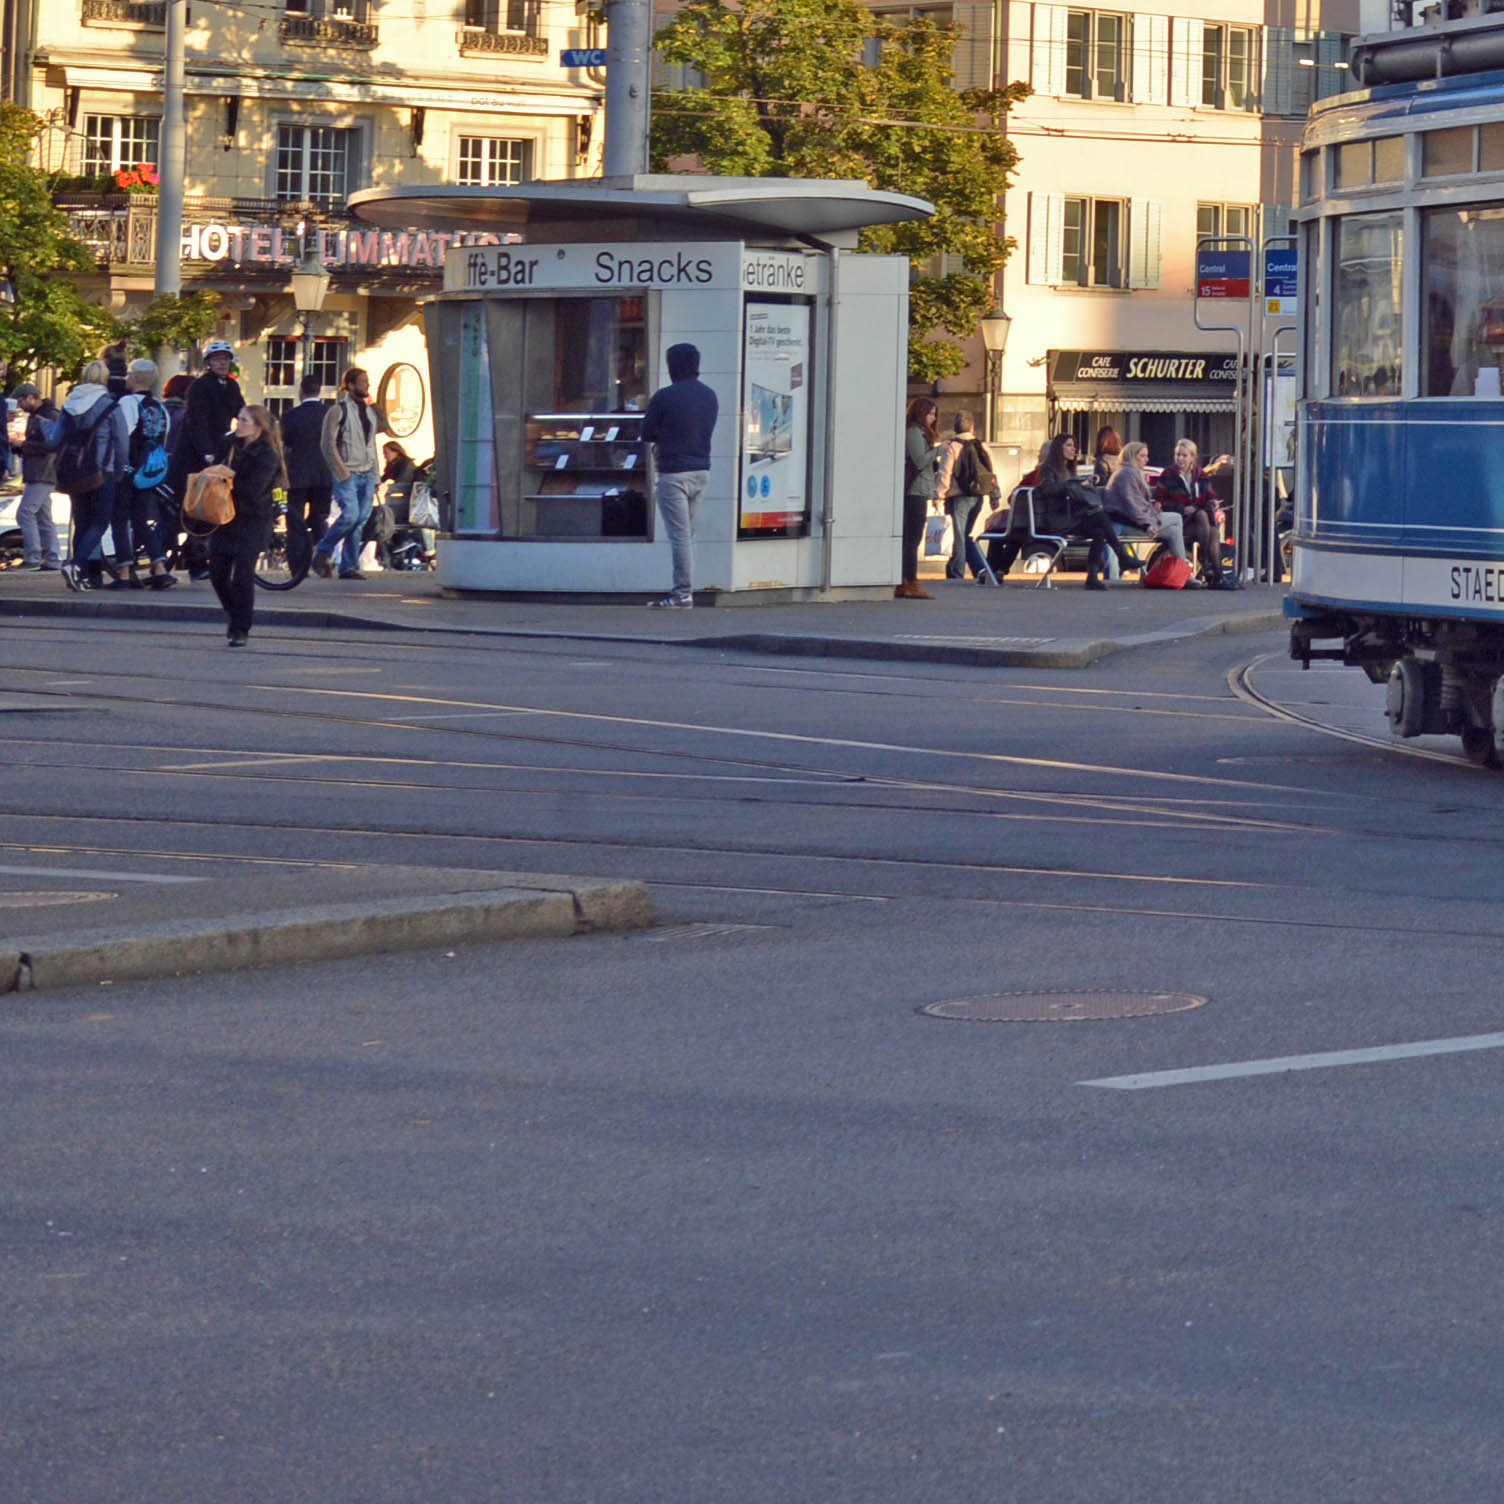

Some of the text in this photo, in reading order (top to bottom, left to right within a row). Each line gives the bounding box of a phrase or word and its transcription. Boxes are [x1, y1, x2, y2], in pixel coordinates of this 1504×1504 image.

[572, 50, 601, 65] WC
[180, 225, 295, 263] HOTEL
[458, 252, 539, 287] ffè-Bar
[595, 252, 713, 284] Snacks
[744, 256, 804, 288] etränke
[1200, 264, 1226, 273] Central
[1267, 263, 1297, 272] Centra
[1201, 286, 1211, 296] 15
[1126, 358, 1205, 379] SCHURTER
